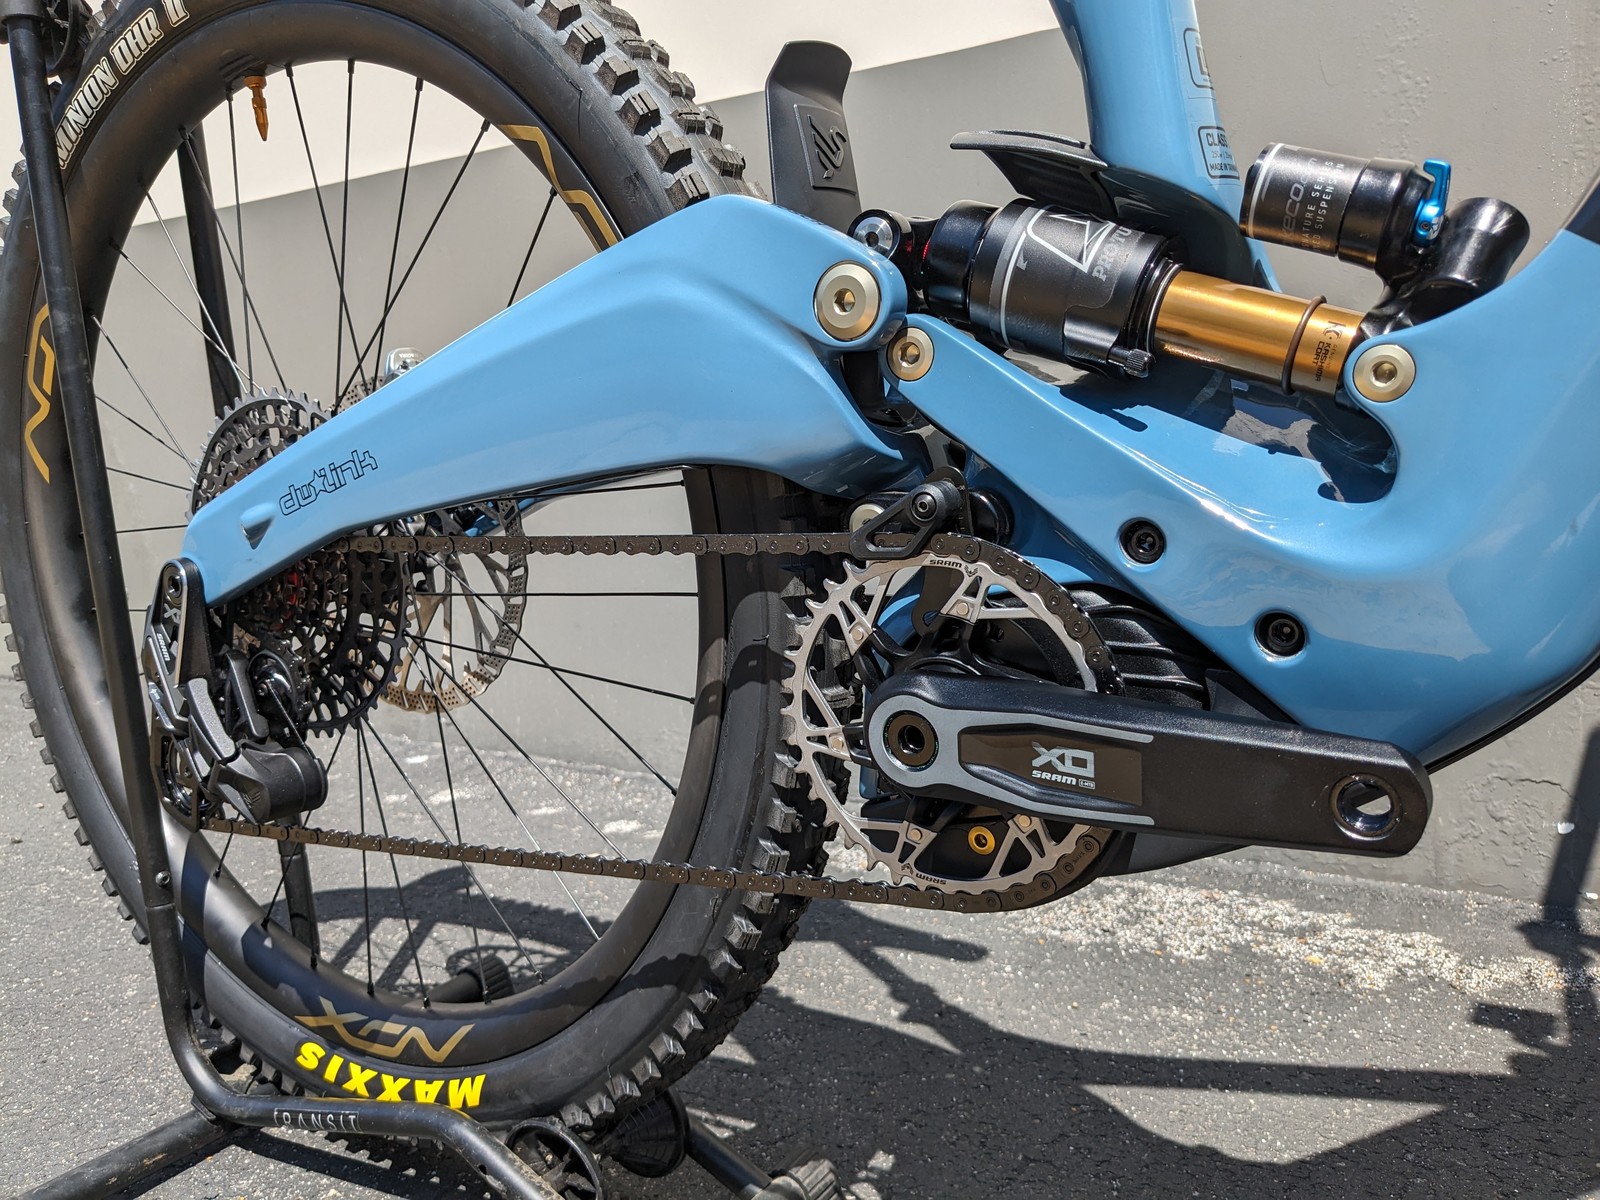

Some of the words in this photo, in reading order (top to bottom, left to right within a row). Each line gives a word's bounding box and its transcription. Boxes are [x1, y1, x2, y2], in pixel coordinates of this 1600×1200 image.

[56, 57, 119, 169] MINION
[110, 8, 164, 75] DHR
[929, 559, 962, 568] SRAM
[156, 633, 171, 661] SRAM
[1031, 770, 1077, 785] SRAM
[916, 872, 947, 885] SRAM
[295, 1041, 486, 1109] MAXXIS
